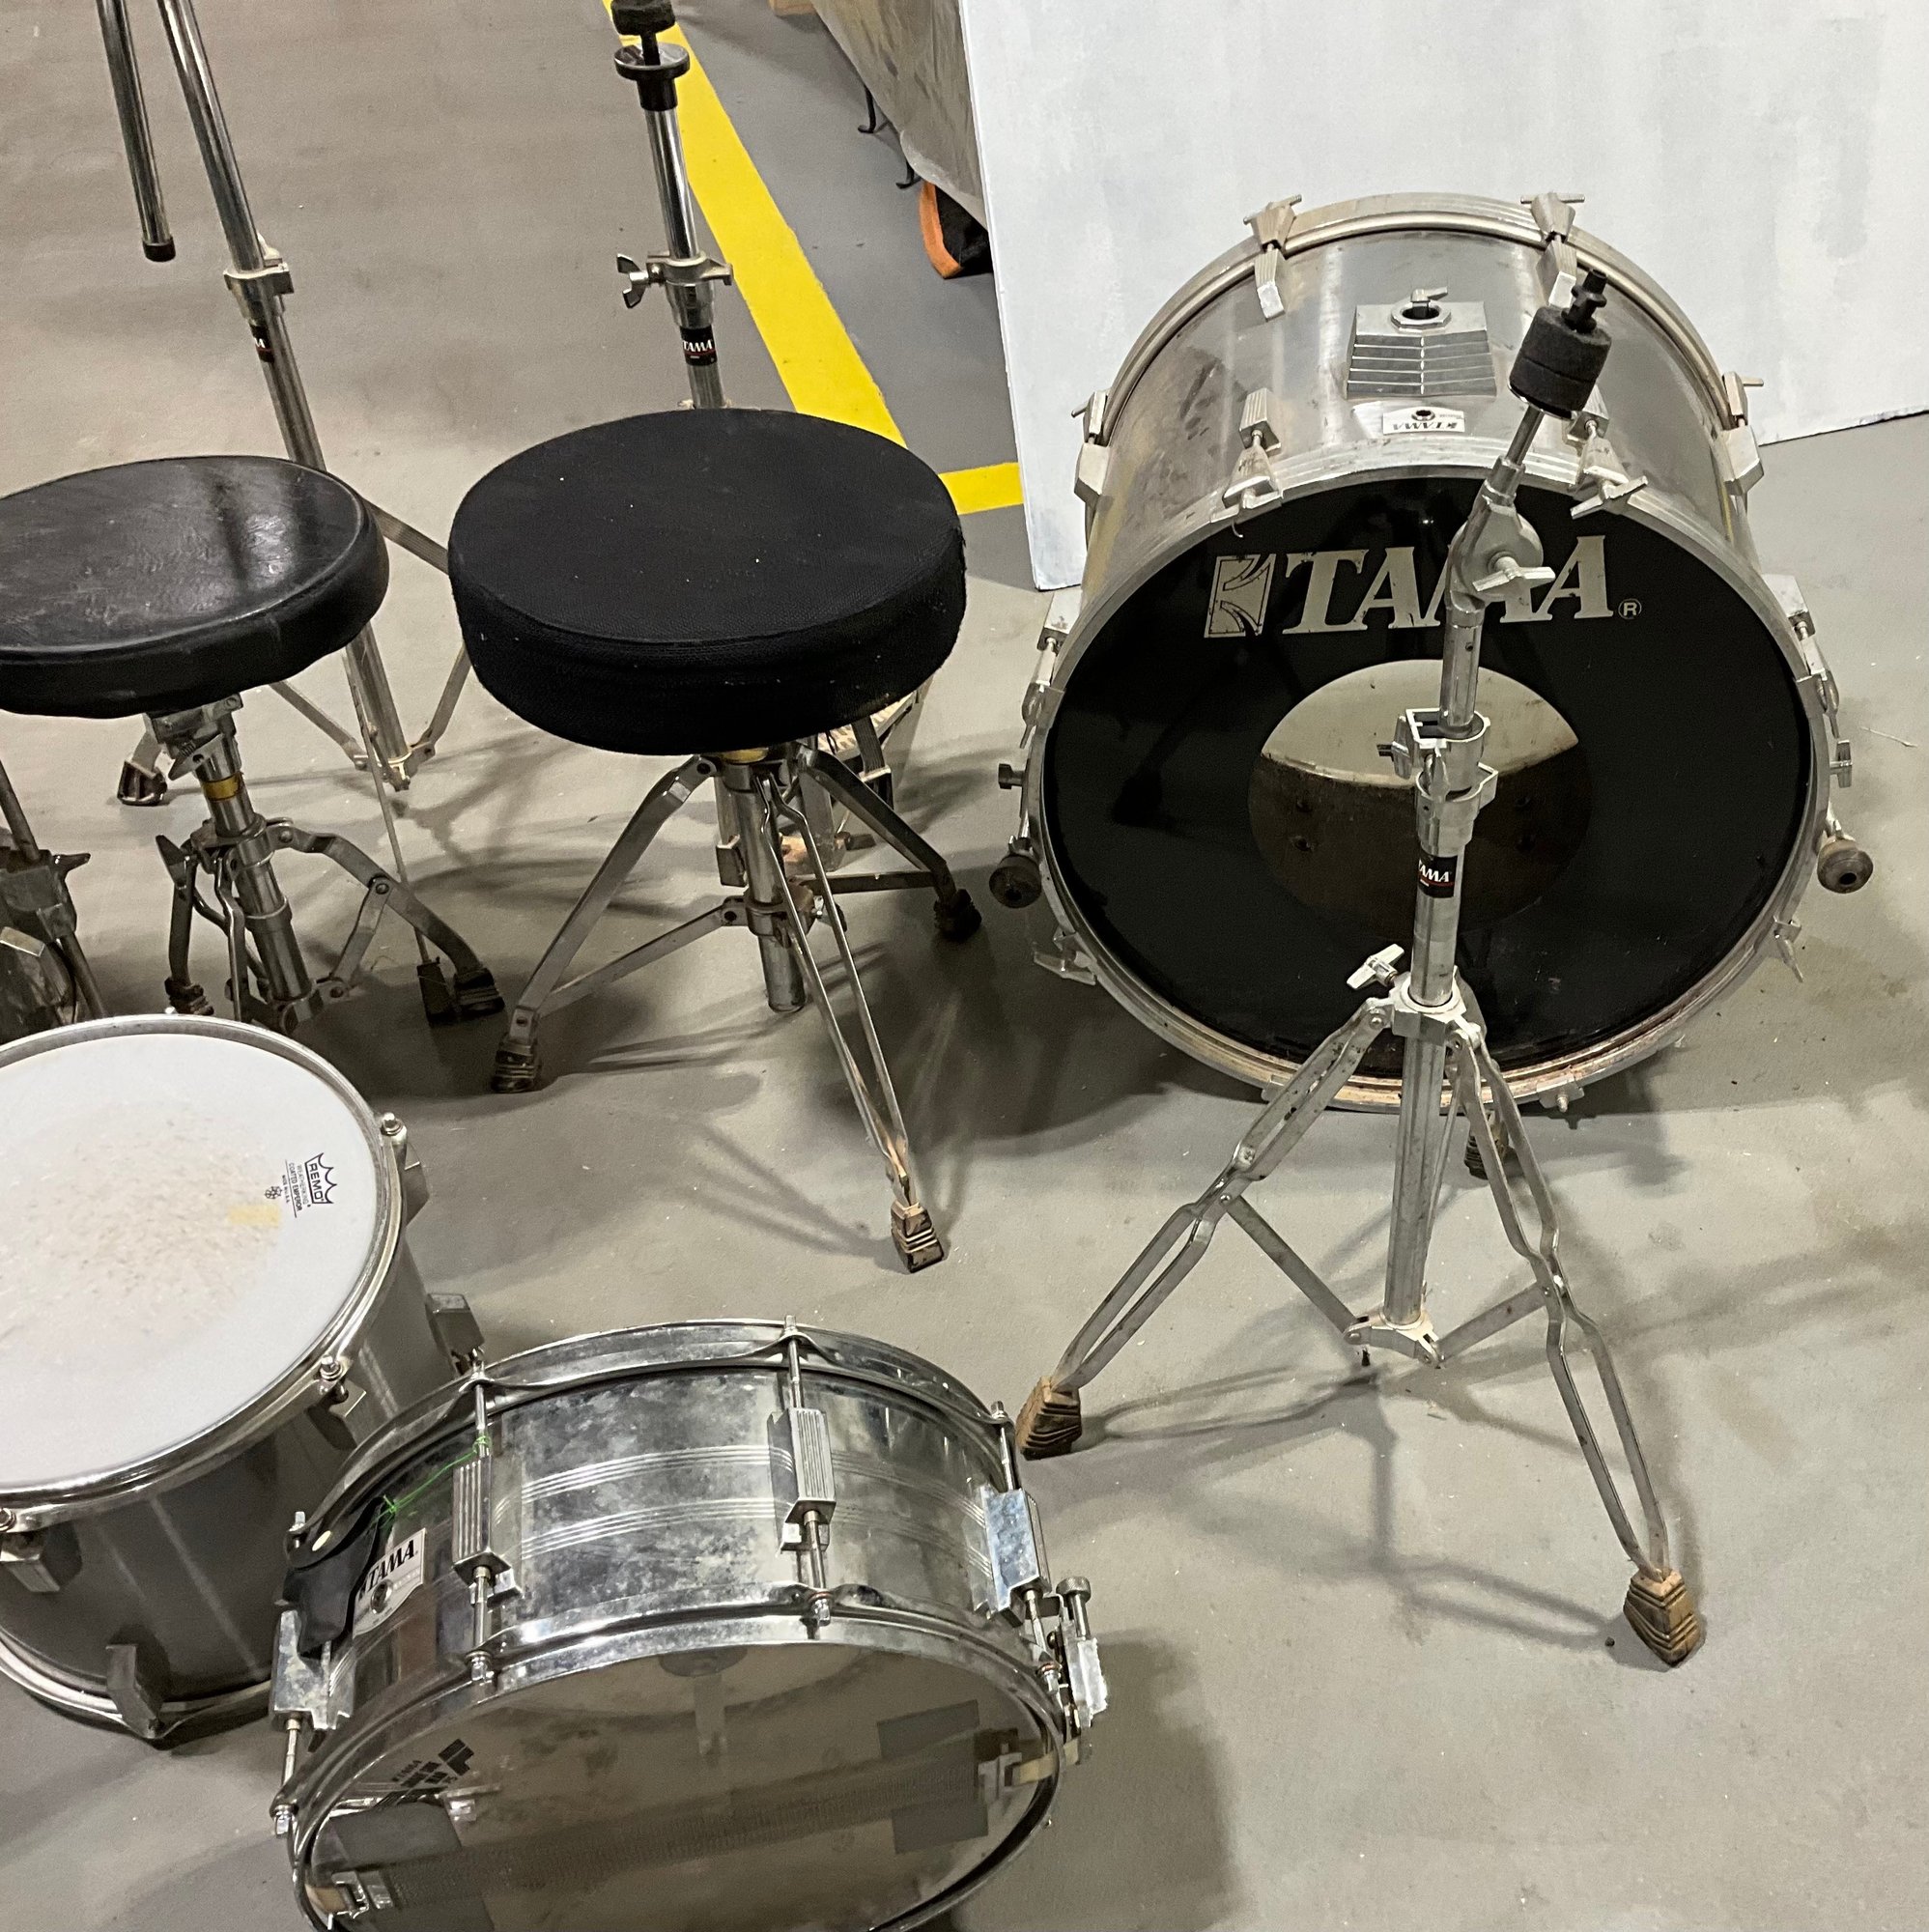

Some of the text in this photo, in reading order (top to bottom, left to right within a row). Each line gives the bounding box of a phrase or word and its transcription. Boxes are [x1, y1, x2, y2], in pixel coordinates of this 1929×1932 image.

[682, 339, 713, 353] TAMA
[289, 1162, 303, 1211] COATED EMPEROR
[297, 1164, 309, 1205] WEATHERKING
[308, 1163, 324, 1201] REMO
[367, 1540, 415, 1592] TAMA
